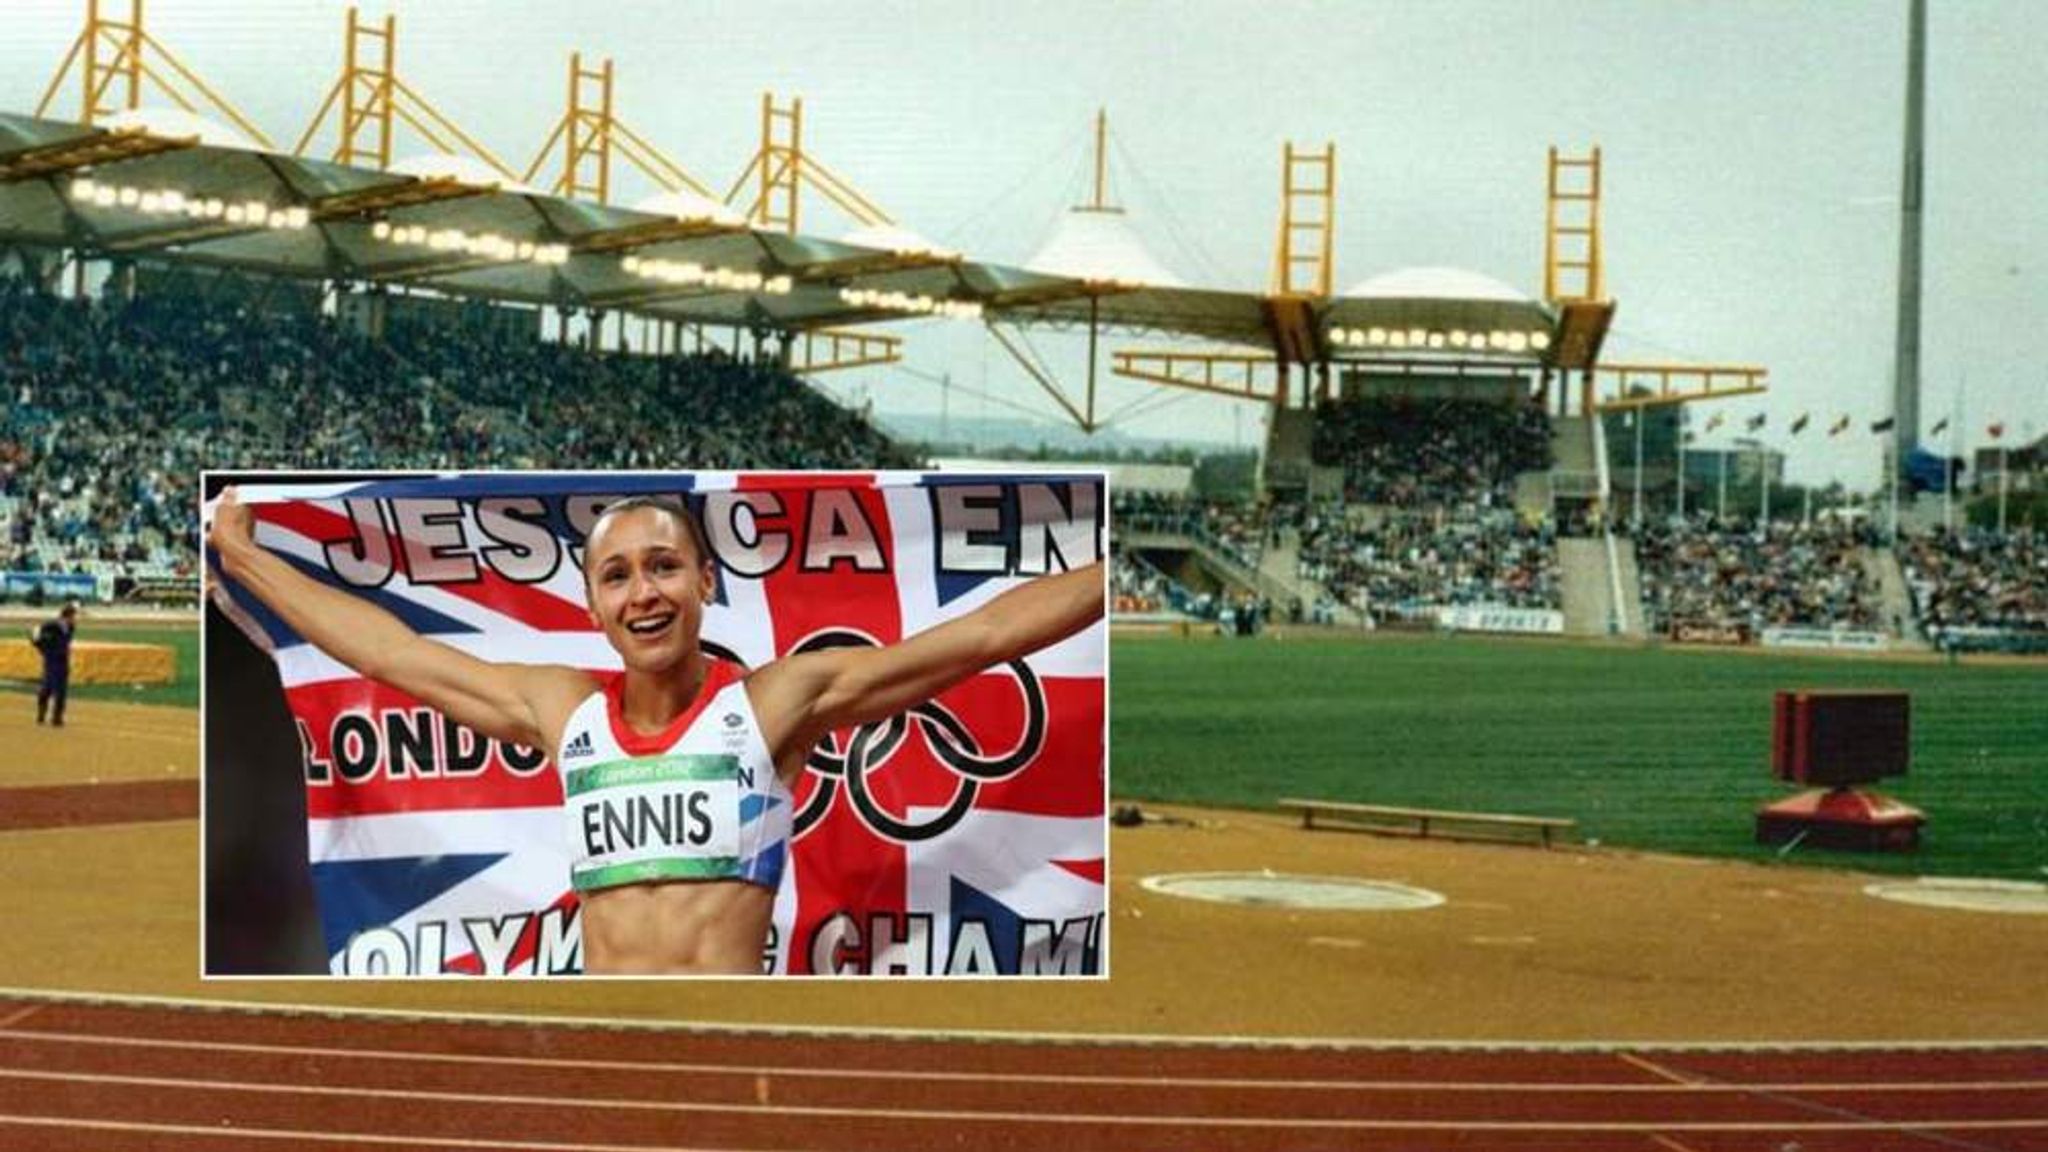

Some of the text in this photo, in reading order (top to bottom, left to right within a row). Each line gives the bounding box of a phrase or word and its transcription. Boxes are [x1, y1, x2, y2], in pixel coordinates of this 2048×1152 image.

[323, 487, 886, 588] JESCA
[582, 790, 713, 857] ENNIS
[810, 910, 1105, 976] CHAM
